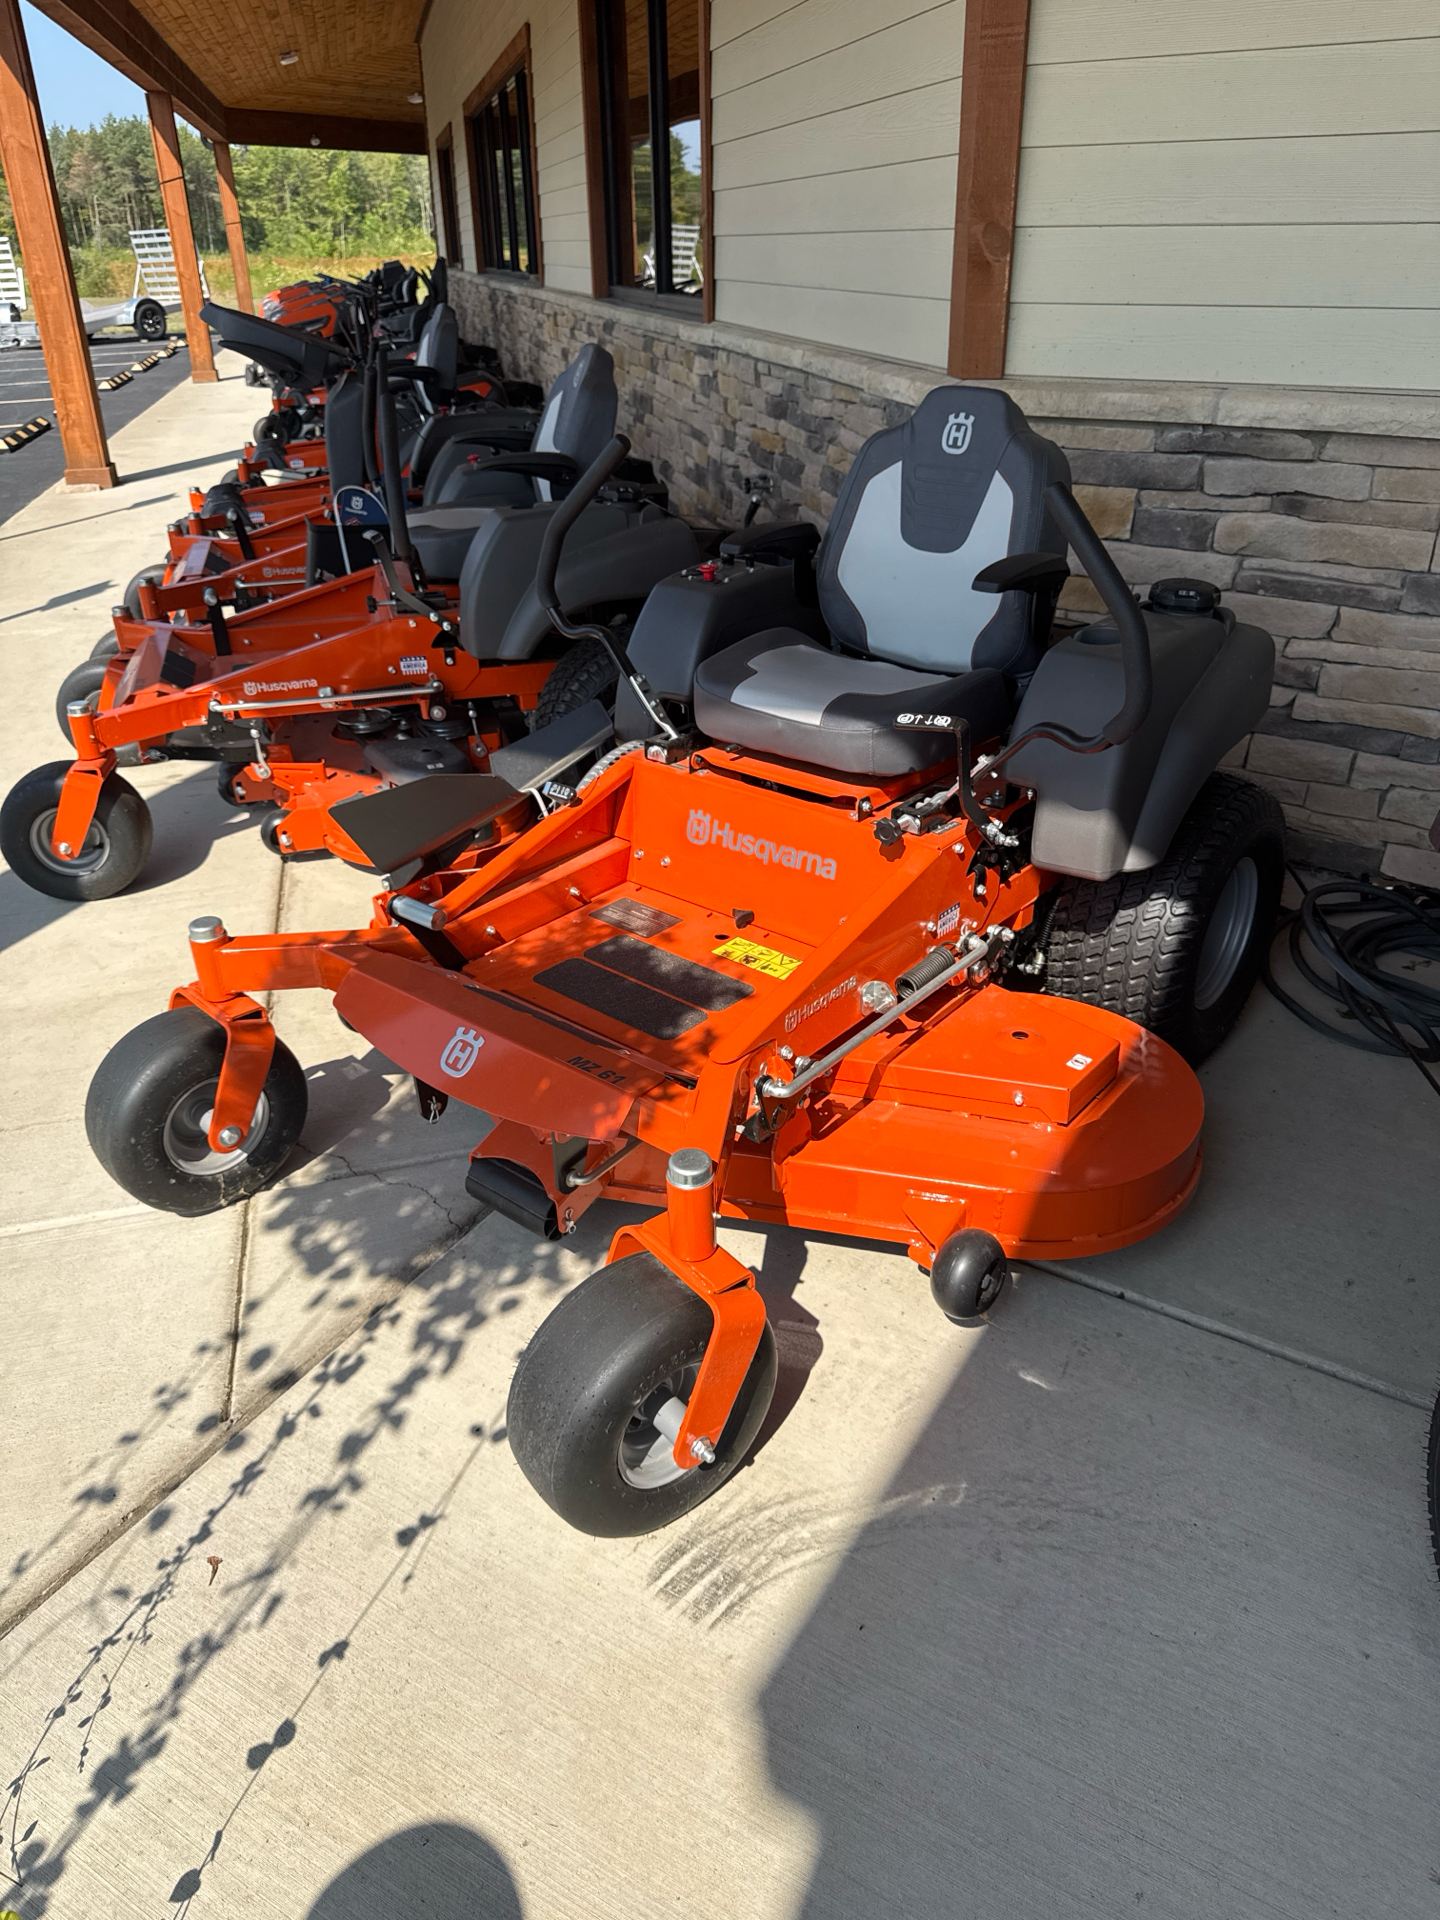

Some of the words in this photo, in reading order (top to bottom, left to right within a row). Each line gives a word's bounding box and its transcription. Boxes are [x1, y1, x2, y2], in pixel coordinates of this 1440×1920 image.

[273, 566, 307, 576] Husqvar
[256, 679, 318, 693] Husqvarna
[711, 819, 838, 881] Husqvarna
[797, 975, 857, 1024] Husqvarna
[566, 1055, 602, 1073] MZ
[597, 1069, 627, 1084] 61
